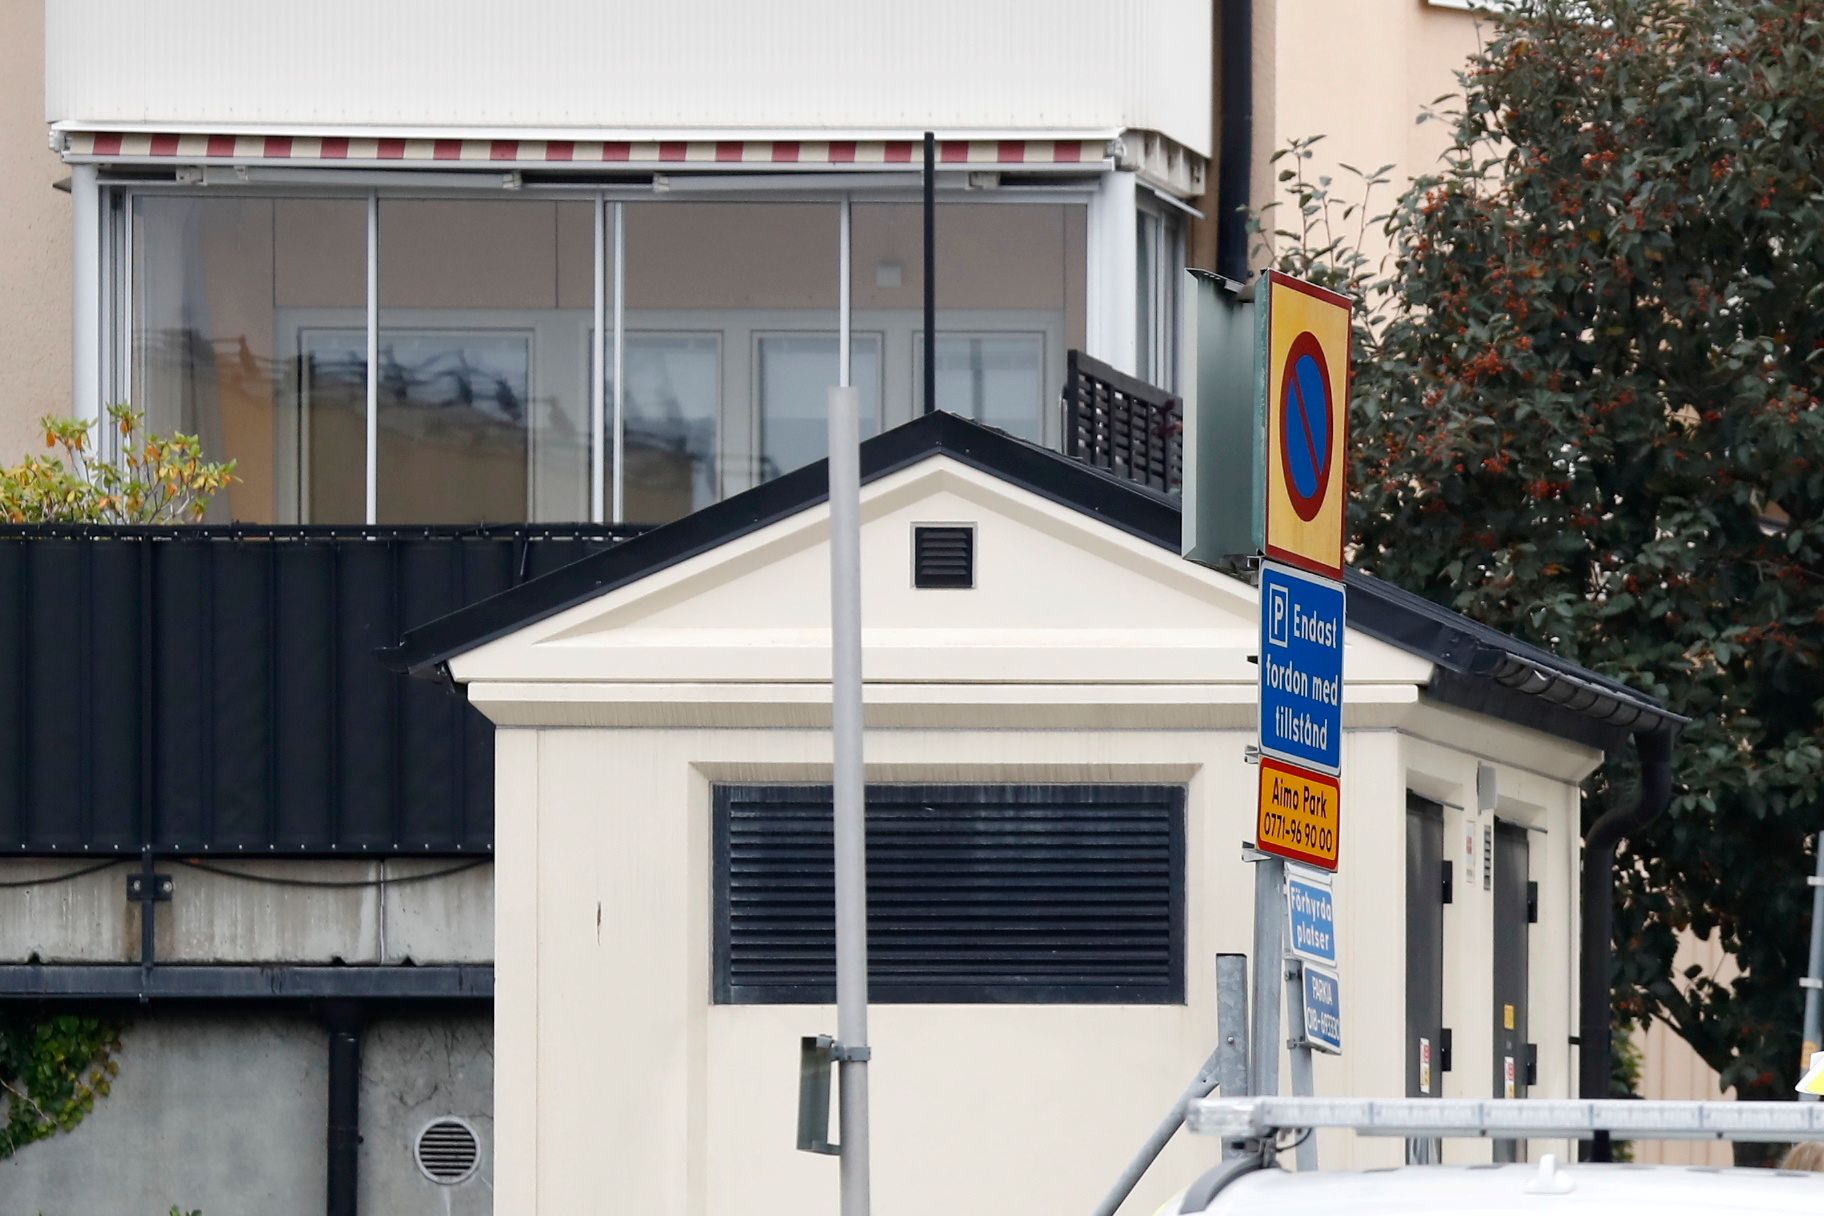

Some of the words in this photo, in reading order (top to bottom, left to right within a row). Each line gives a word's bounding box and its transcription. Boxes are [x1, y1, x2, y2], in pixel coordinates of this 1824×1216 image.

[1294, 603, 1336, 649] Endast
[1266, 653, 1308, 698] fordon
[1312, 674, 1338, 707] med
[1276, 705, 1328, 751] tillstånd
[1272, 777, 1299, 810] Aimo
[1302, 785, 1327, 819] Park
[1264, 812, 1302, 844] 0771-96
[1304, 823, 1317, 848] 90
[1319, 828, 1333, 852] 00
[1291, 886, 1332, 922] Förhyrda
[1297, 921, 1329, 950] platser
